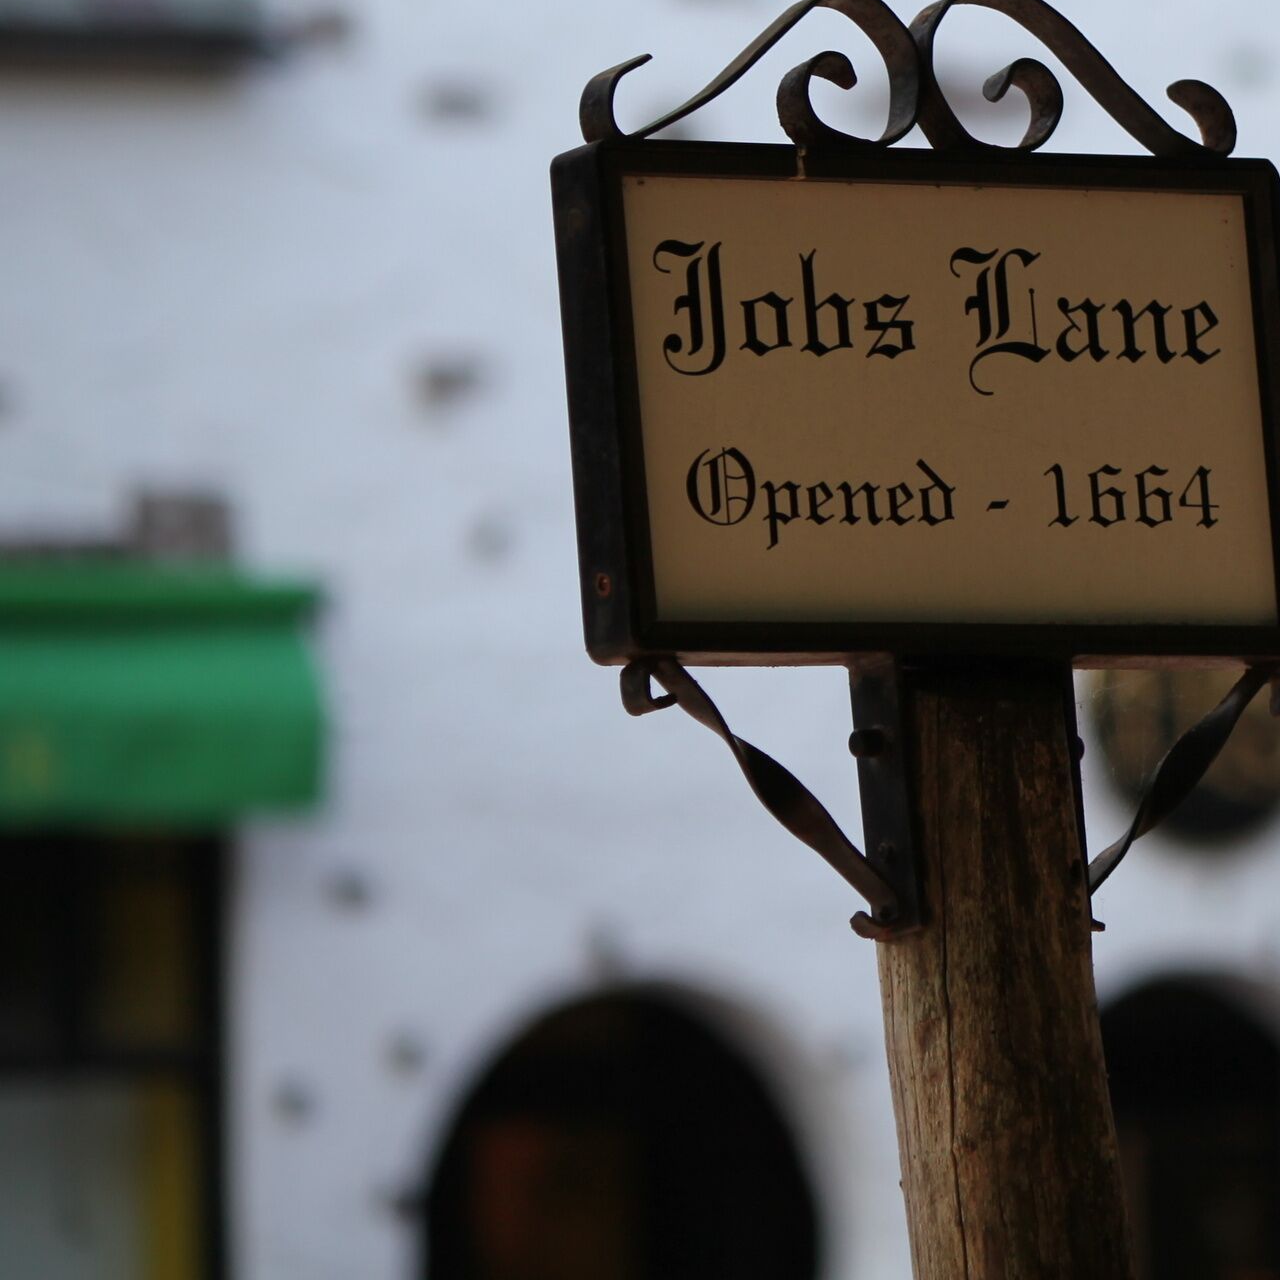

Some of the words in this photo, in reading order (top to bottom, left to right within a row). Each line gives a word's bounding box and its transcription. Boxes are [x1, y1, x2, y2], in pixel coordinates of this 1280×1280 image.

[652, 239, 917, 376] Jobs
[949, 246, 1222, 396] Lane
[685, 446, 956, 551] Opened
[986, 498, 1010, 513] -
[1043, 462, 1220, 530] 1664
